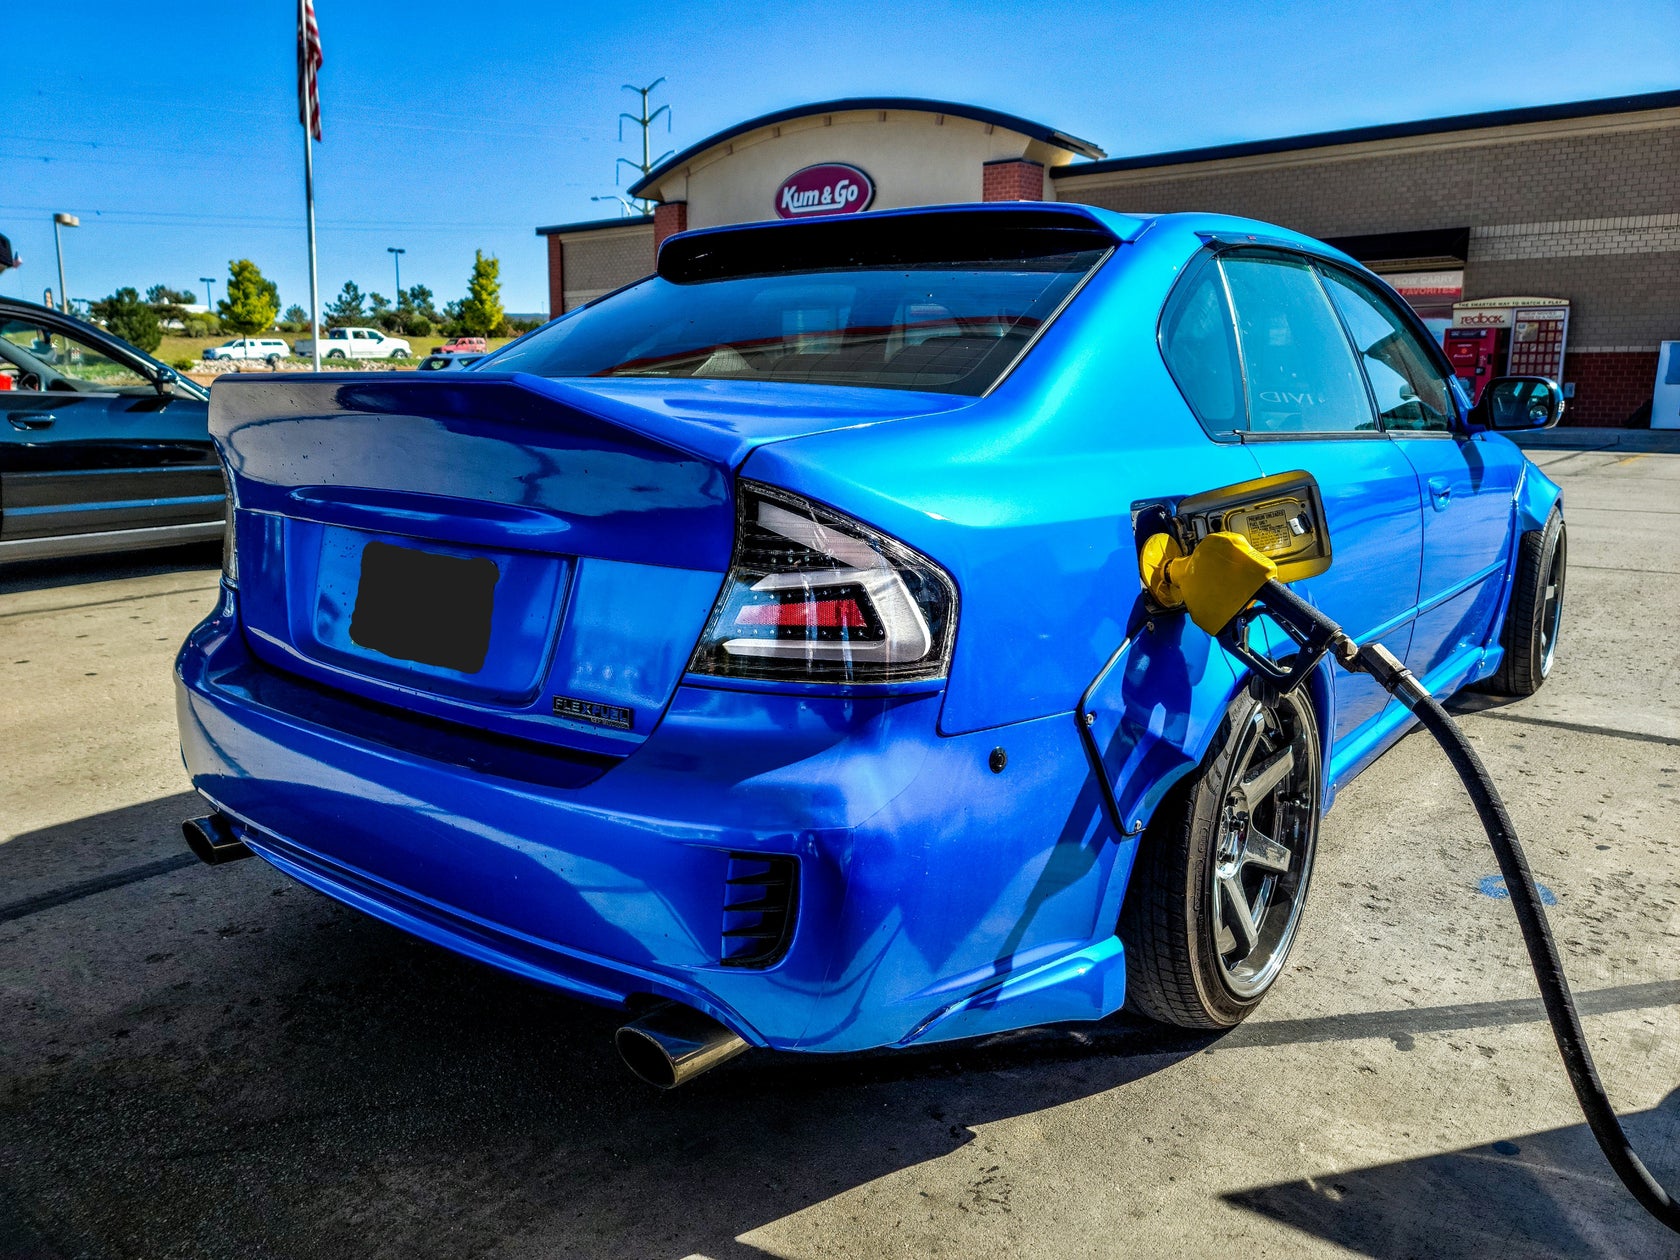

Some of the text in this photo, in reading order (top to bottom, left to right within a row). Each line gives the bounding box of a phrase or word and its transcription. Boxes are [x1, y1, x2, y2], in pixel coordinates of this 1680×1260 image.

[782, 180, 858, 211] Kum & Go
